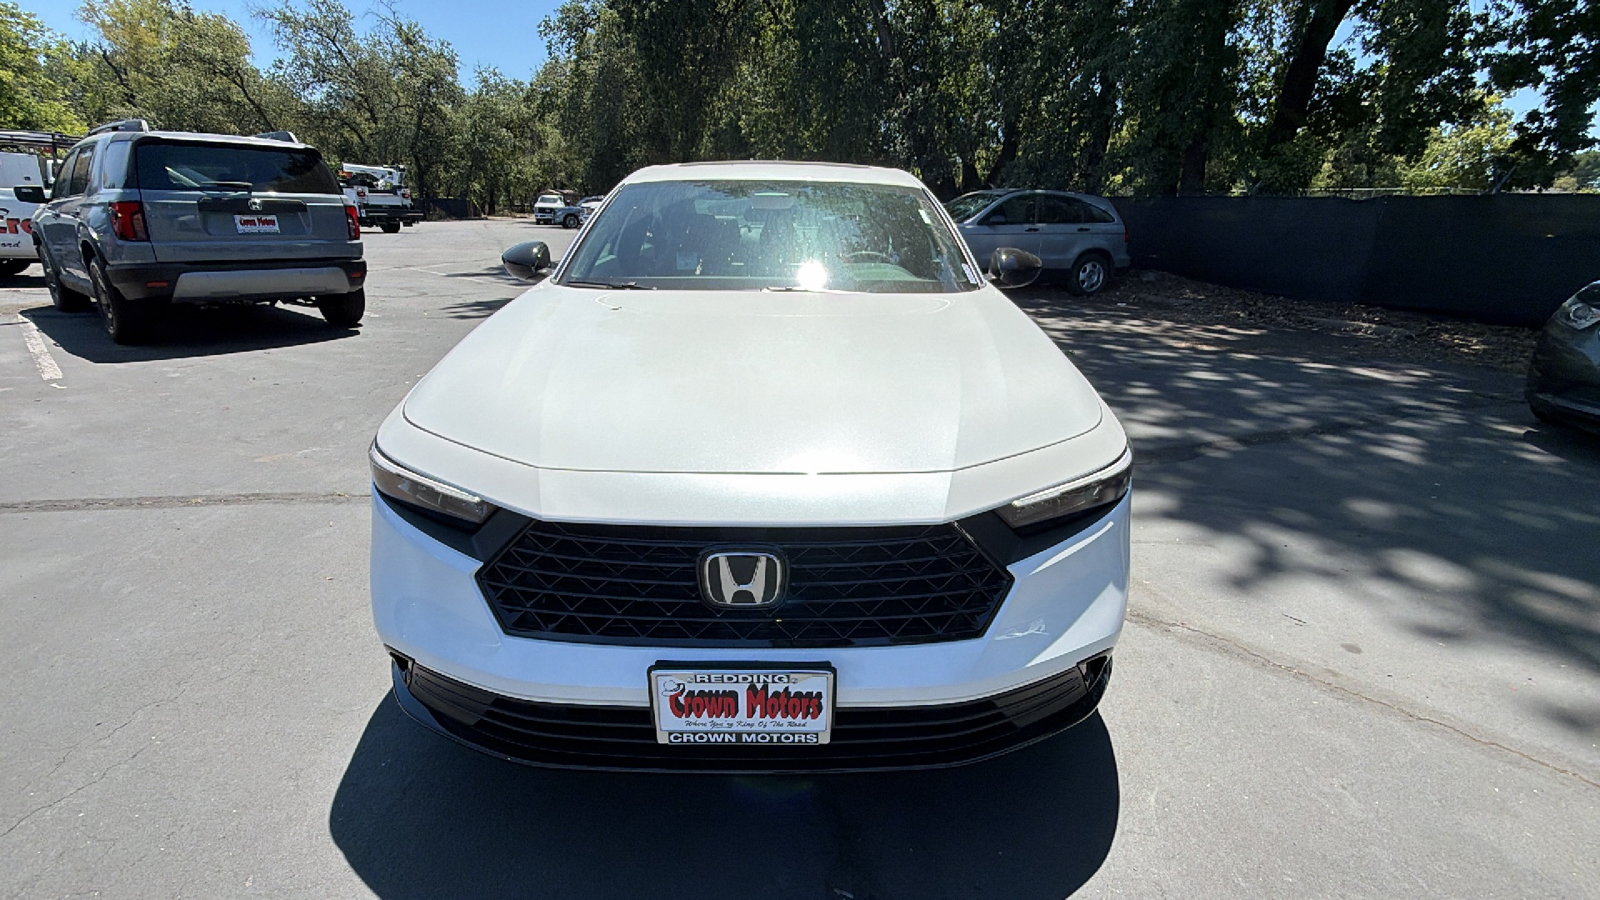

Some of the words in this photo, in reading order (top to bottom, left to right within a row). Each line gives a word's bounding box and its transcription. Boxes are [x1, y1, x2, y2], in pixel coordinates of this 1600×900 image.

[696, 674, 789, 684] REDDING
[669, 683, 739, 719] Crown
[746, 684, 823, 720] Motors
[736, 720, 755, 728] King
[758, 720, 768, 728] Of
[670, 732, 736, 743] CROWN
[742, 732, 818, 743] MOTORS
